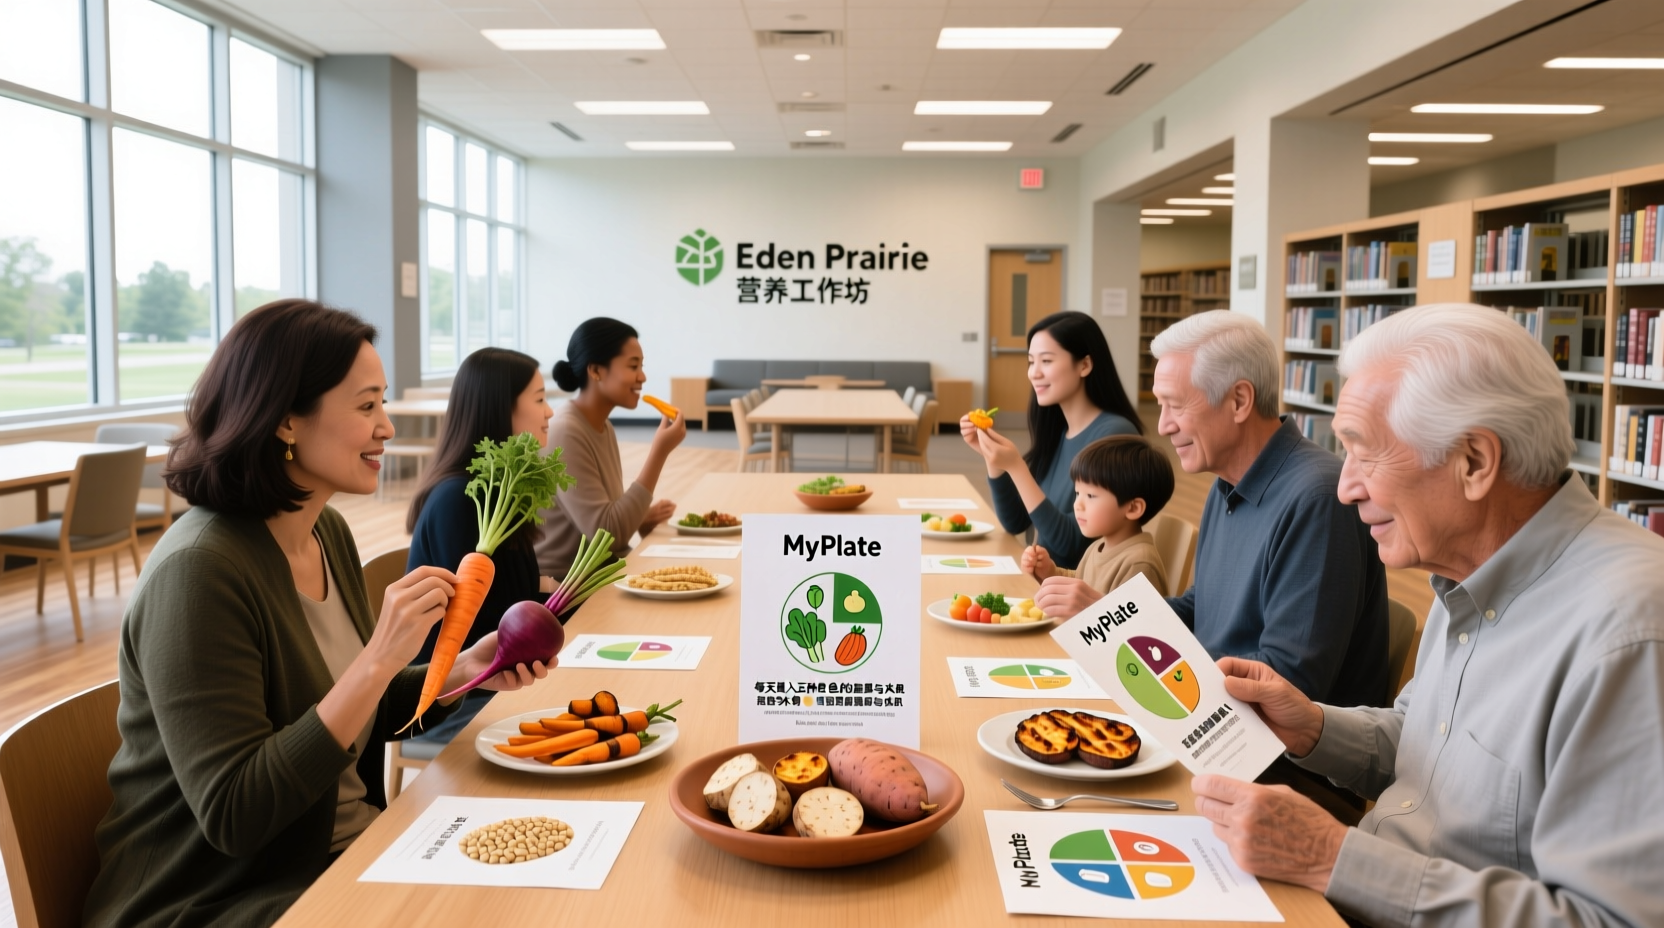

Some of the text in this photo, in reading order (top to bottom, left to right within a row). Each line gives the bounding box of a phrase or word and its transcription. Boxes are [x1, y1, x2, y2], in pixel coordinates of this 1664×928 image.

[736, 242, 929, 271] Eden Prairie
[736, 276, 871, 304] 营养工作坊
[783, 534, 882, 562] MyPlate
[1079, 600, 1140, 647] MyPlate
